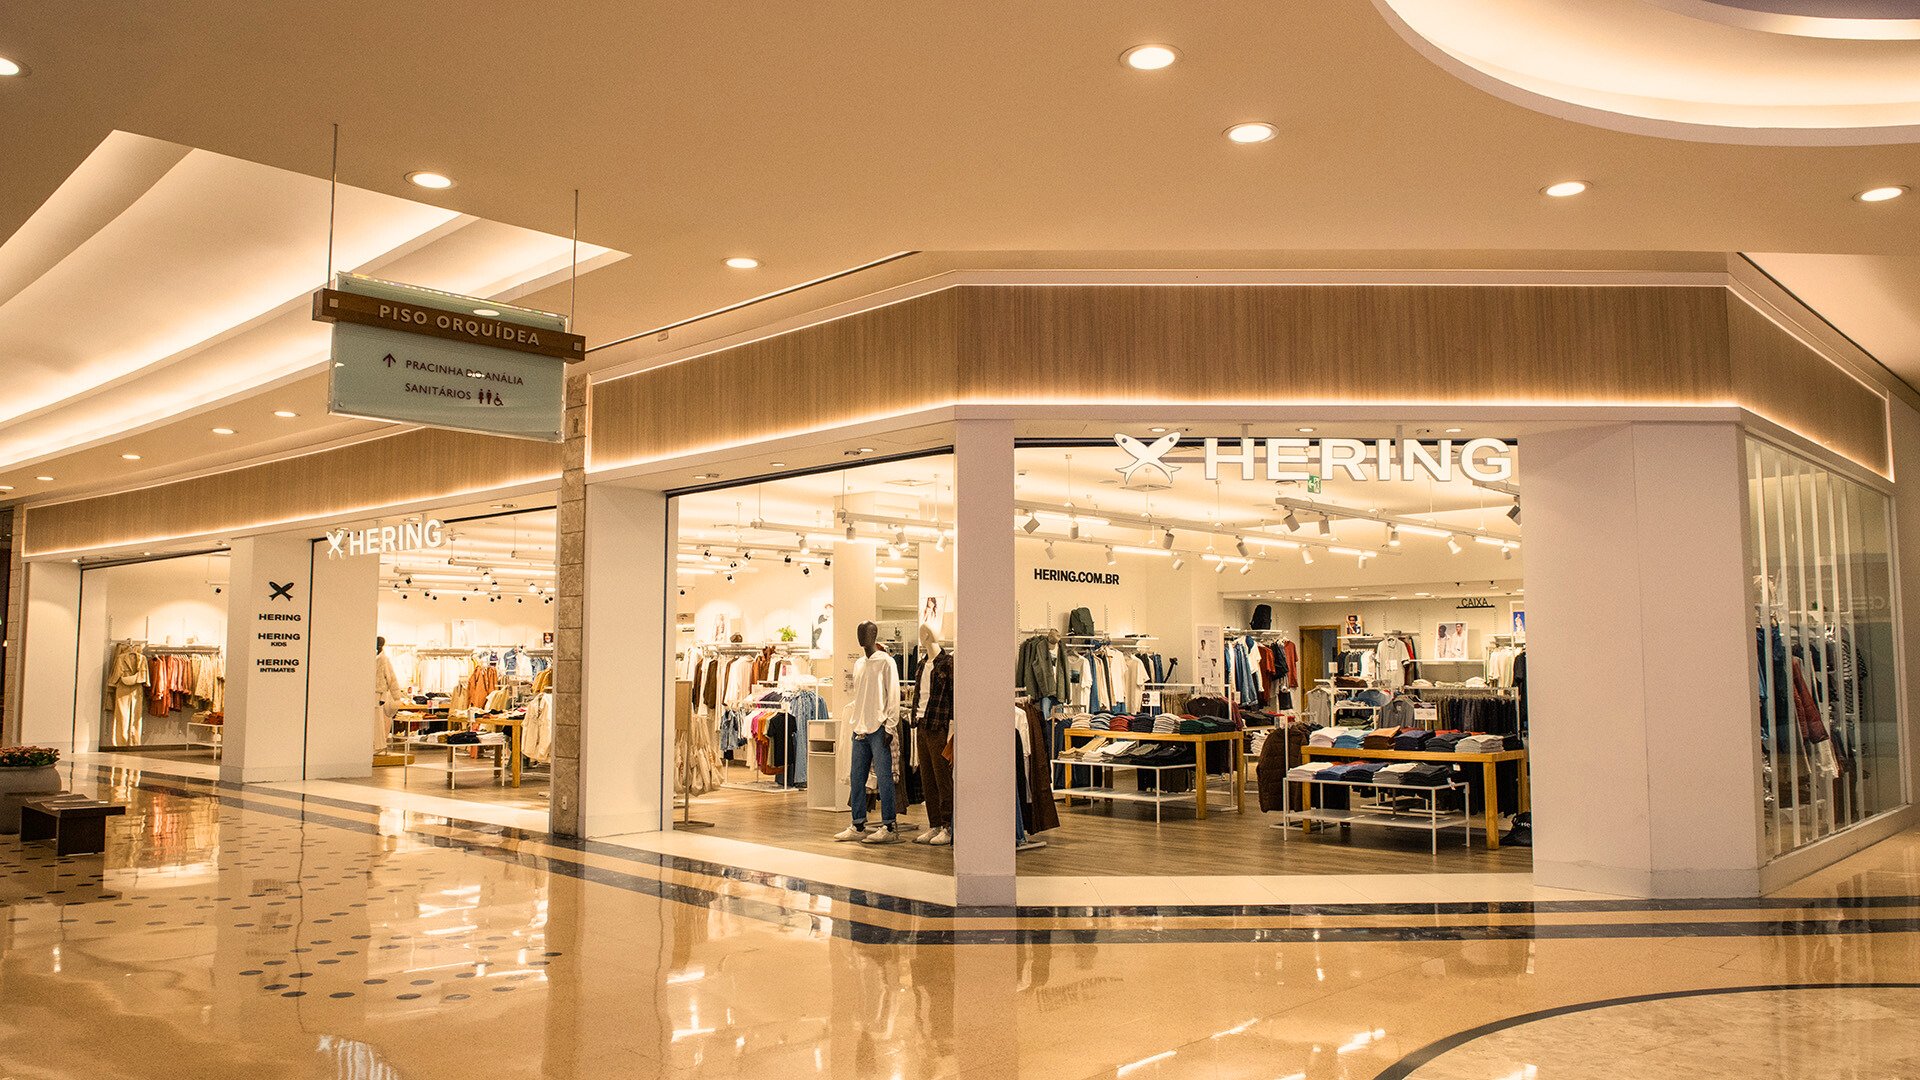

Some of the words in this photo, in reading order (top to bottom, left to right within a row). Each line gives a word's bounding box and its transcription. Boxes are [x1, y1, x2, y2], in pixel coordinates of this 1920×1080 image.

[378, 304, 428, 325] PISO
[435, 315, 540, 346] ORQUÍDEA
[405, 359, 464, 377] PRACINHA
[484, 371, 524, 386] ANÁLIA
[404, 382, 472, 400] SANITÁRIOS
[1203, 437, 1513, 482] HERING
[348, 518, 443, 556] HERING
[1033, 568, 1120, 585] HERING.COM.BR
[1461, 597, 1489, 607] CAIXA
[258, 613, 302, 621] HERING
[257, 632, 301, 640] HERING
[256, 658, 300, 667] HERING
